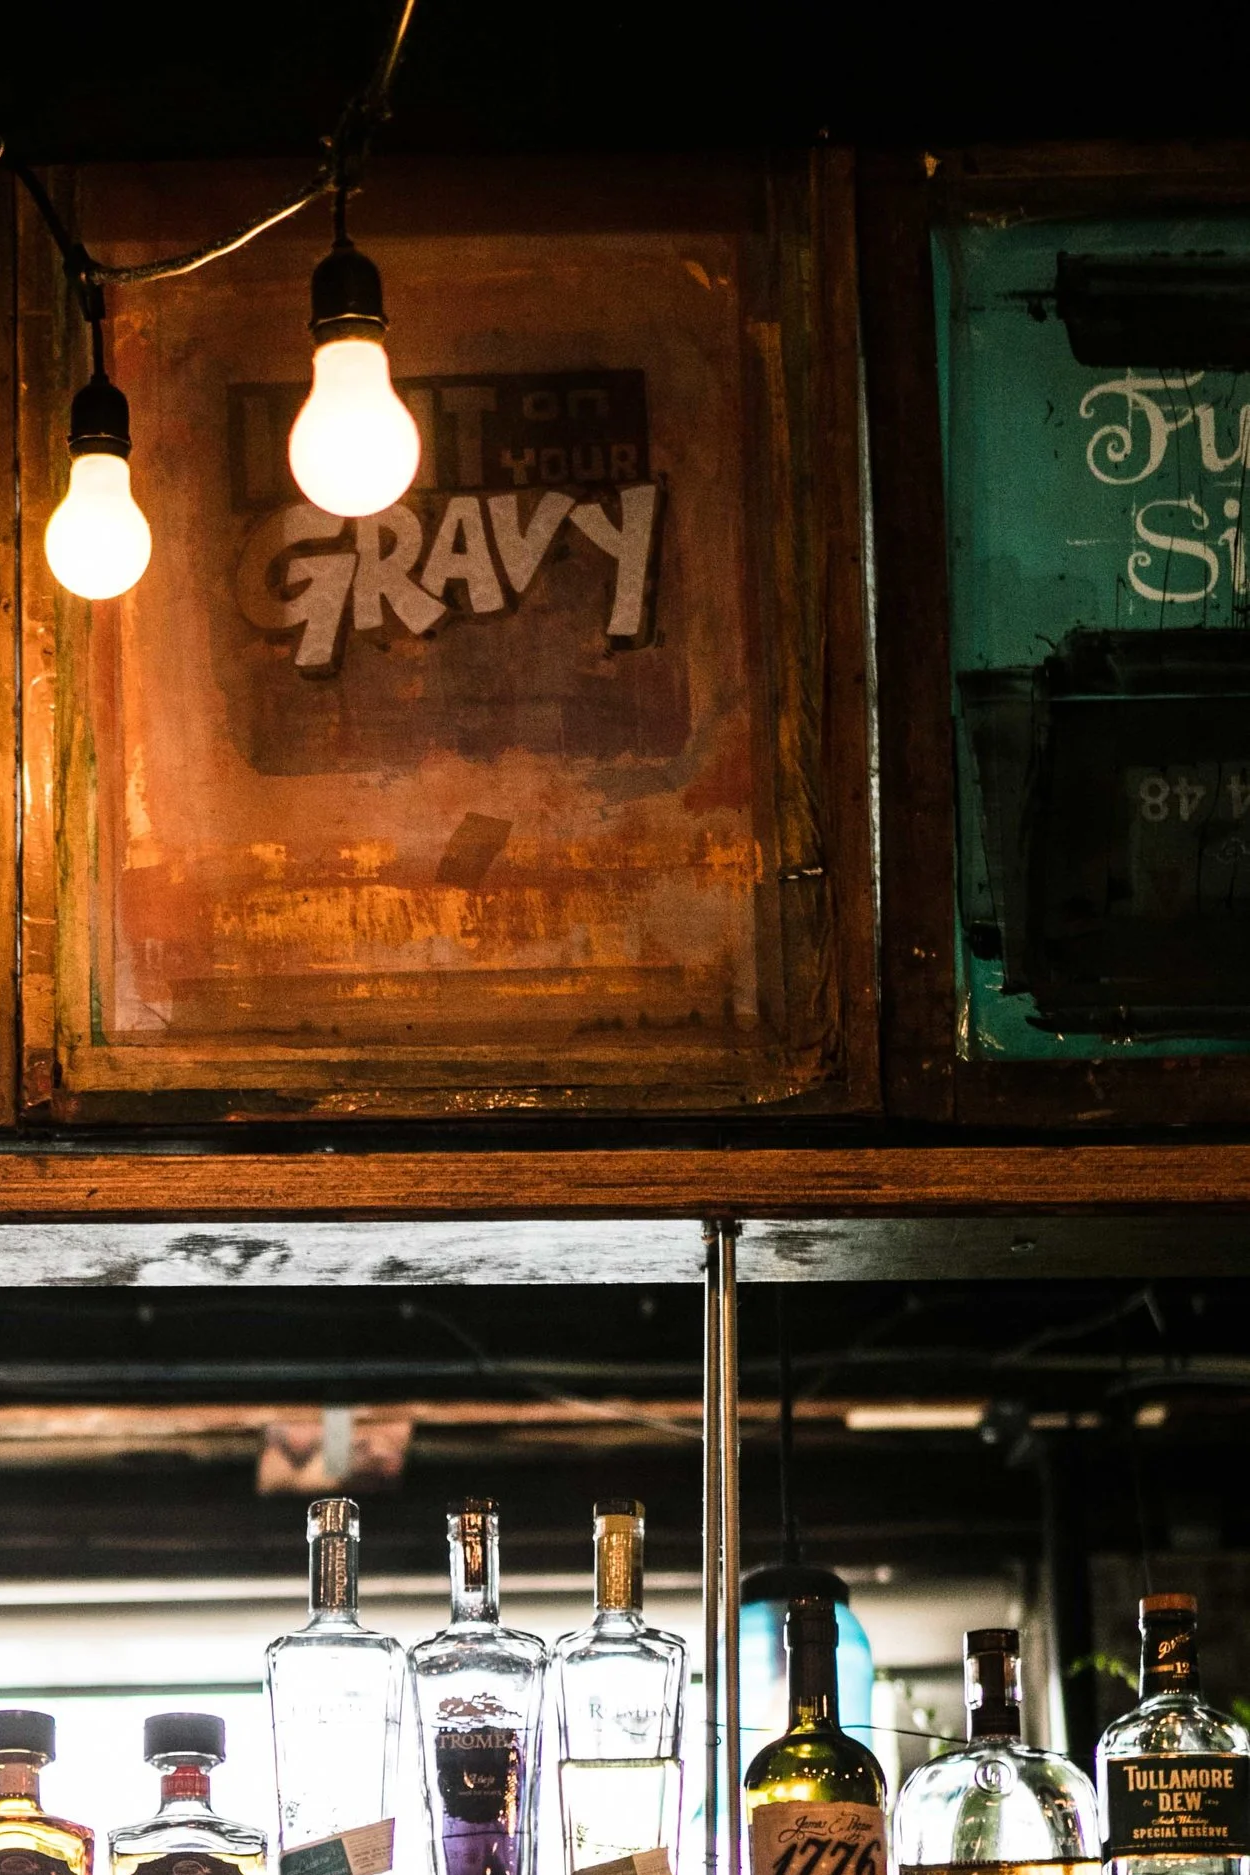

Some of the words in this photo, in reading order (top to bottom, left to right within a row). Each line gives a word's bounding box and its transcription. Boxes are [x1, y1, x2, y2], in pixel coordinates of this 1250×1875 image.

[501, 442, 637, 486] YOUR
[240, 478, 660, 669] GRAVY
[1175, 1661, 1190, 1674] 12
[1123, 1765, 1235, 1792] TULLAMORE
[1132, 1827, 1178, 1839] SPECIAL
[1181, 1826, 1229, 1838] RESERVE
